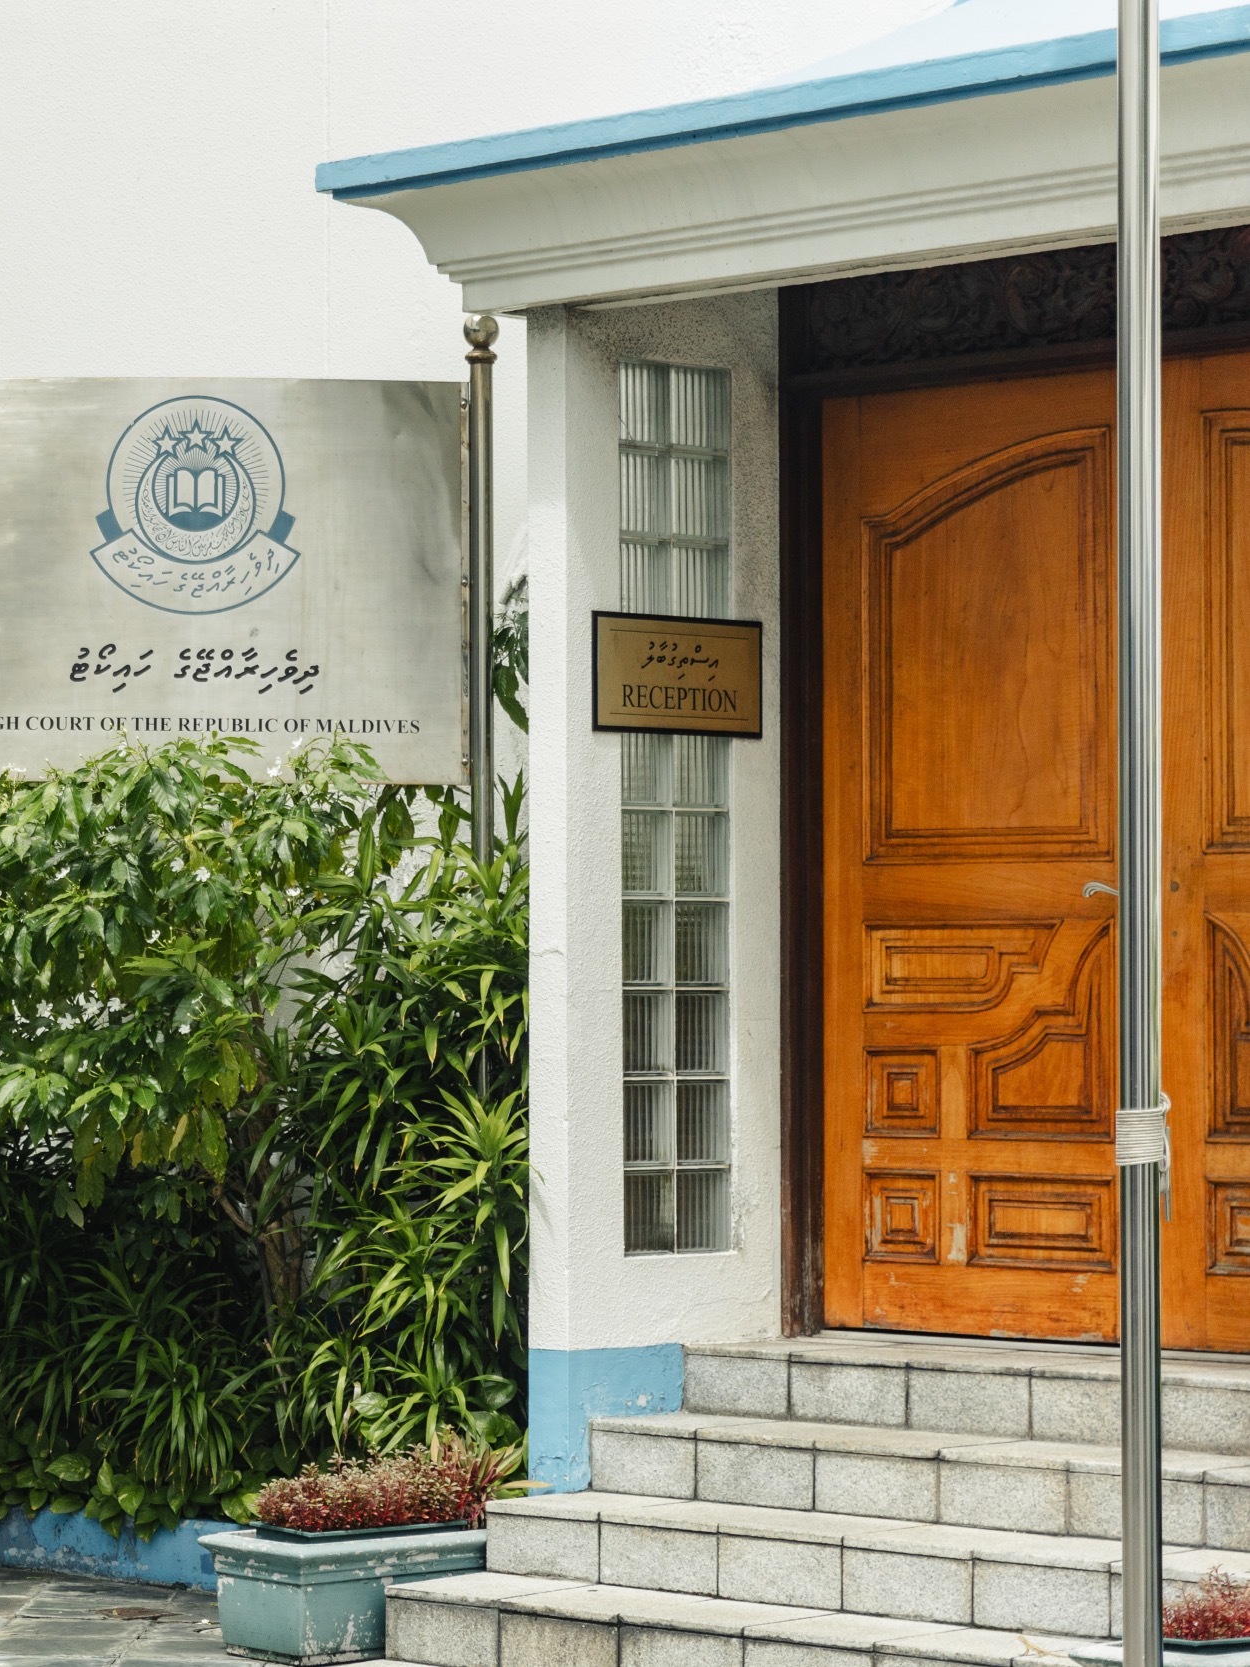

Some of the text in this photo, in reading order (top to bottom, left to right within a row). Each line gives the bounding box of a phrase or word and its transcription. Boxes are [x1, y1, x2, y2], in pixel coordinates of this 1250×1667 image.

[69, 643, 320, 695] ދިވެހިރާއްޖޭގެ ހައިކޯޓު
[621, 683, 738, 713] RECEPTION
[25, 715, 96, 732] COURT
[100, 716, 127, 732] OF
[131, 716, 173, 732] THE
[177, 717, 279, 733] REPUBLIC
[283, 717, 311, 733] OF
[316, 718, 421, 734] MALDIVES
